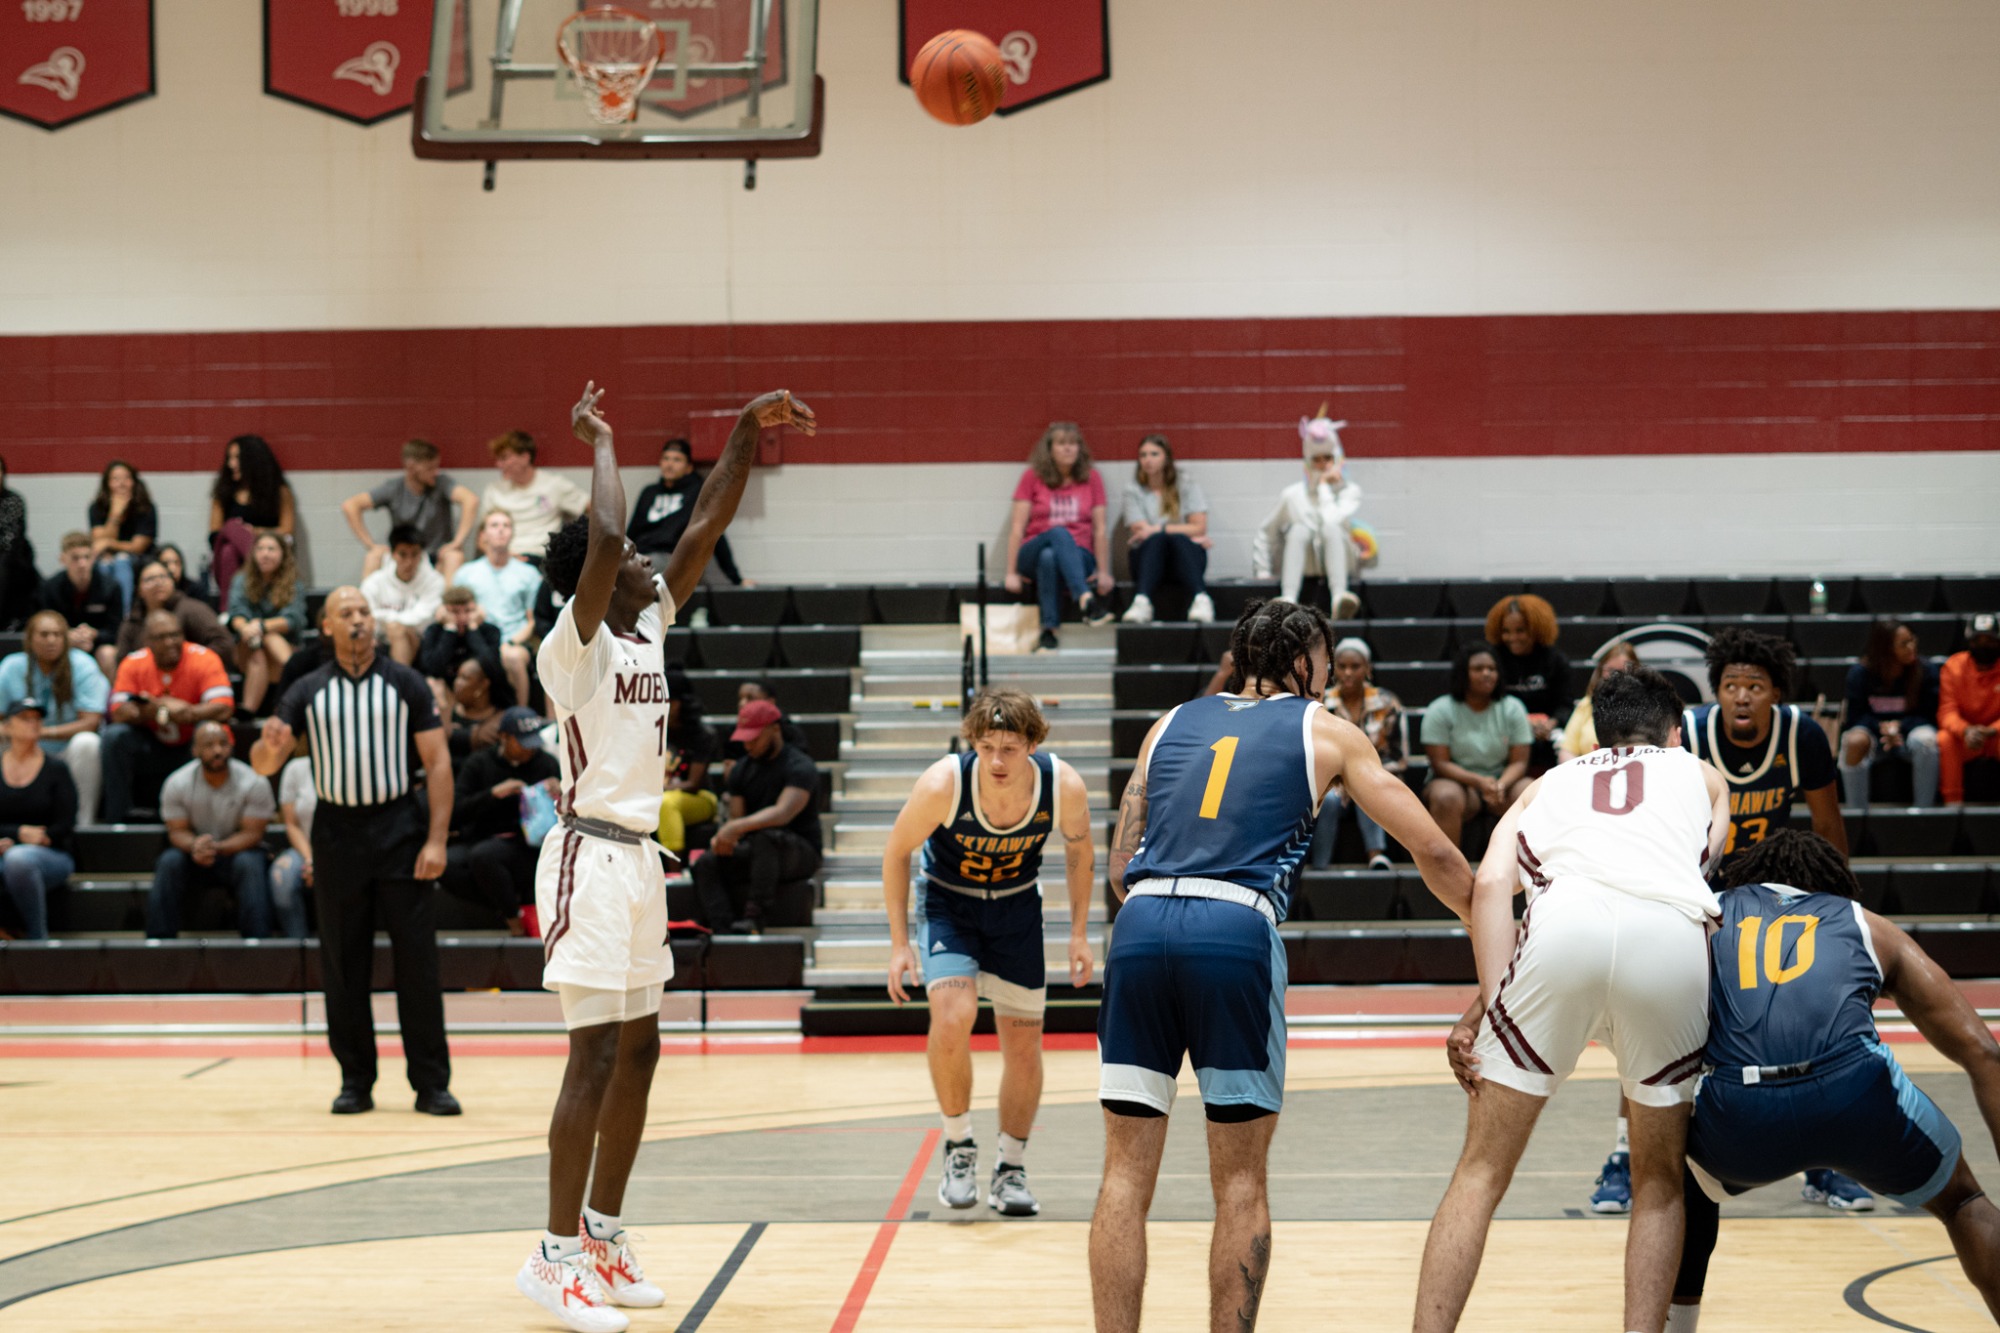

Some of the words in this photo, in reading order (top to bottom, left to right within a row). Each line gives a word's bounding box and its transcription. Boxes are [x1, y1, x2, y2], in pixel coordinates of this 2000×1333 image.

[614, 673, 670, 704] MOB
[1198, 735, 1240, 820] 1
[1592, 760, 1644, 816] 0
[960, 851, 1025, 883] 22
[1736, 913, 1820, 990] 10
